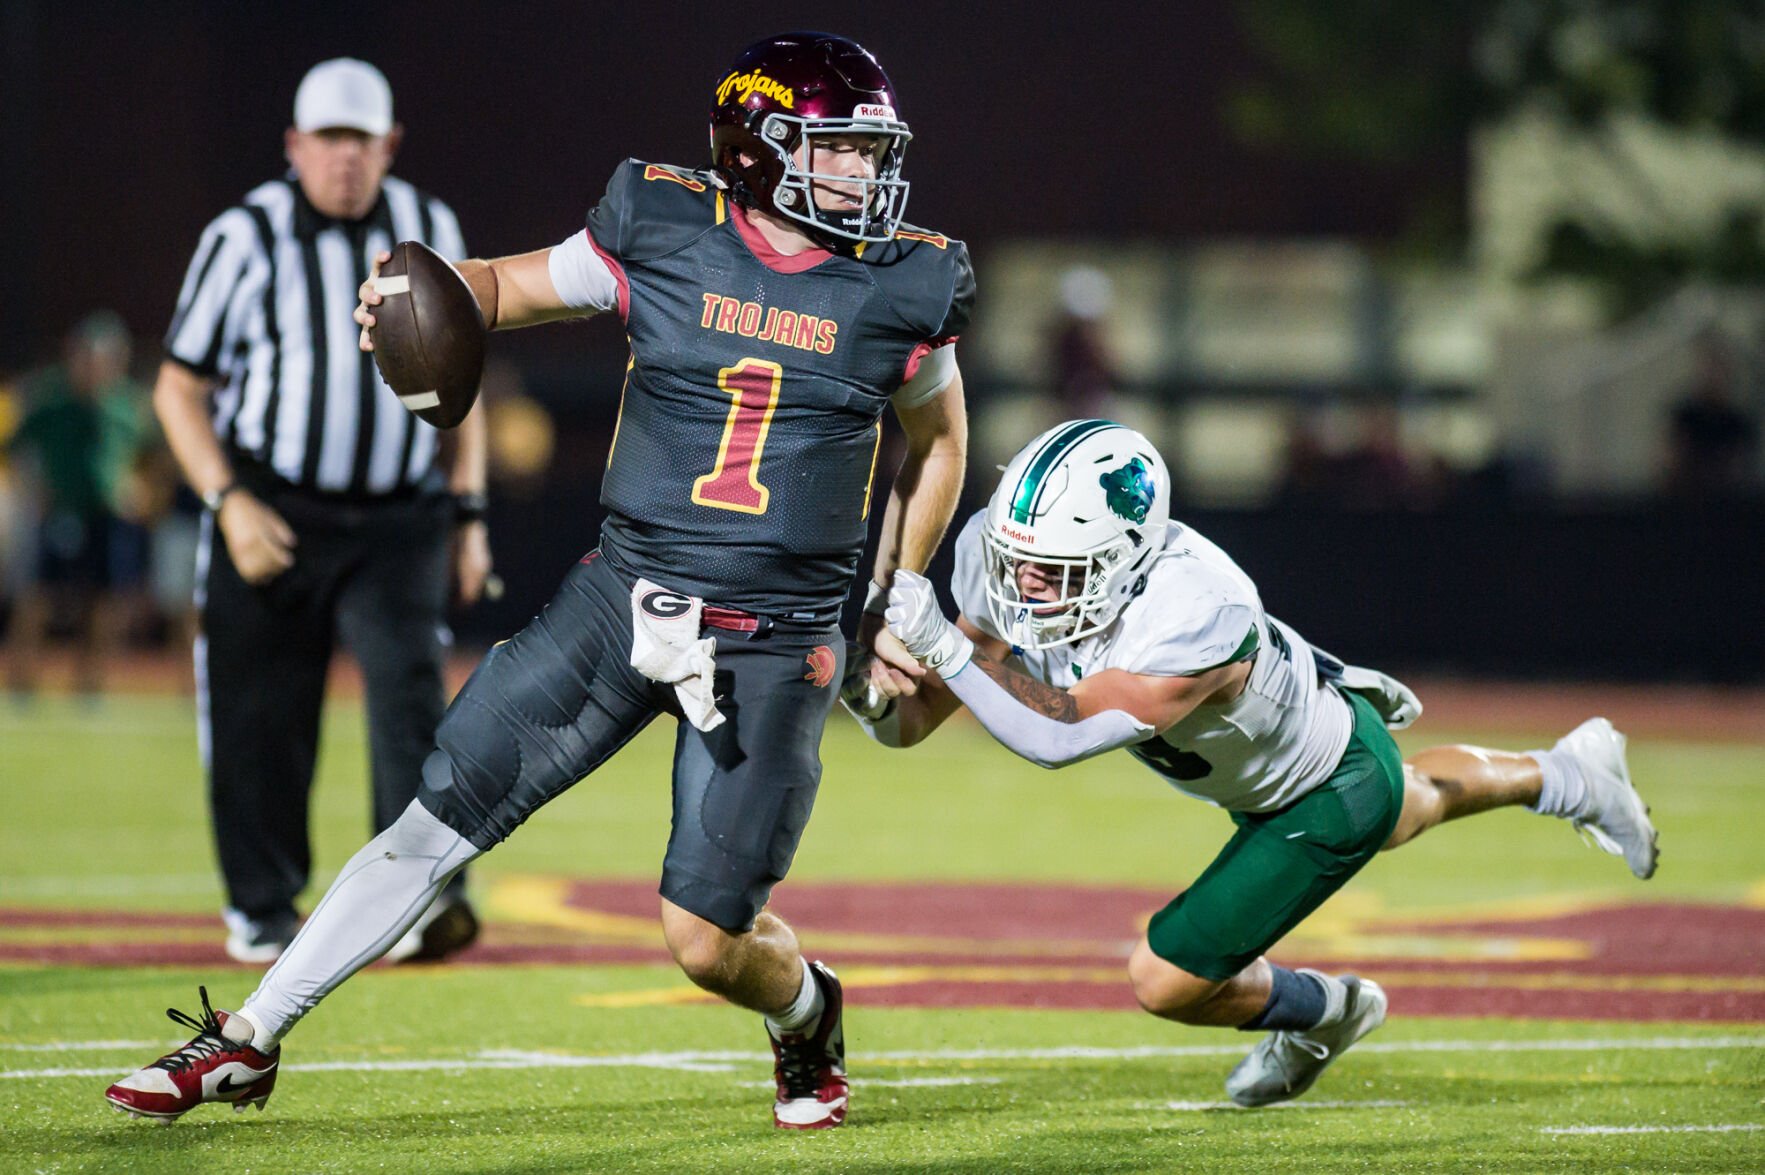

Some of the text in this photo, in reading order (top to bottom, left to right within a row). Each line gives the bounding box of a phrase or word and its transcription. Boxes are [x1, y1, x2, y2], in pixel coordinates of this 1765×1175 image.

[716, 68, 794, 109] Trojans
[860, 106, 894, 118] Ridde
[701, 292, 838, 355] TROJANS
[691, 356, 783, 515] 1
[1001, 524, 1035, 545] Riddell
[640, 591, 692, 618] G
